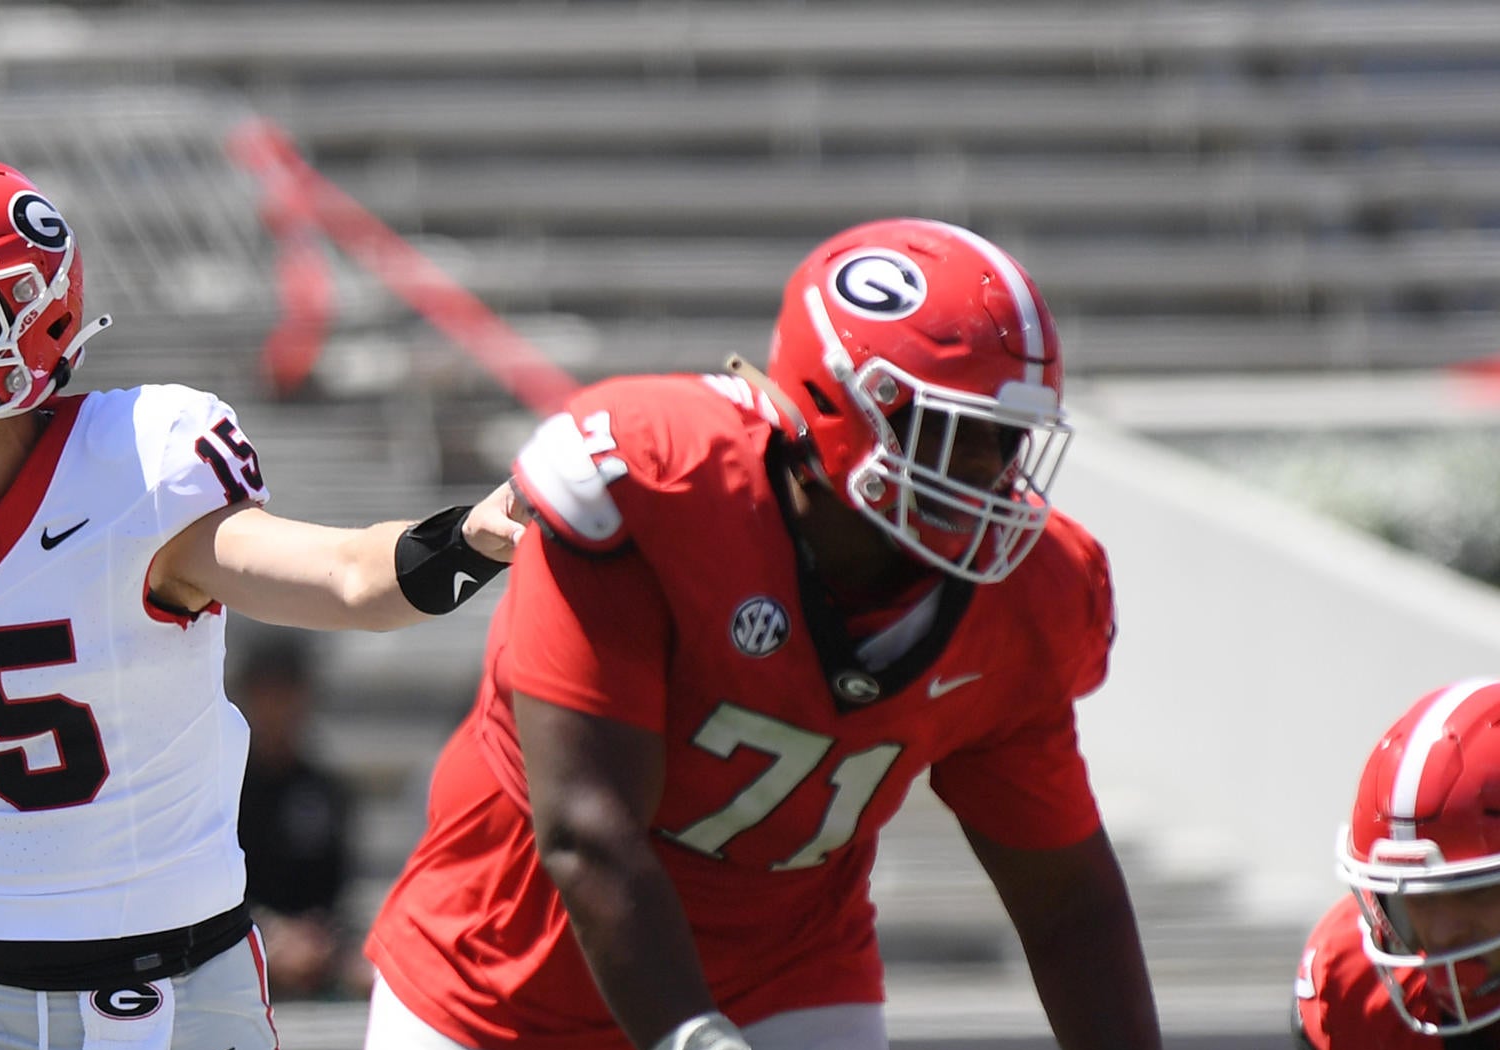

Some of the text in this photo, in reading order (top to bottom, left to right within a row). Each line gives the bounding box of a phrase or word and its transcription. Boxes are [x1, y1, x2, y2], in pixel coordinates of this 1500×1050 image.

[13, 193, 69, 248] G
[835, 255, 920, 312] G
[194, 416, 265, 506] 15
[736, 601, 786, 653] SEC
[650, 699, 906, 872] 71
[93, 983, 160, 1017] G
